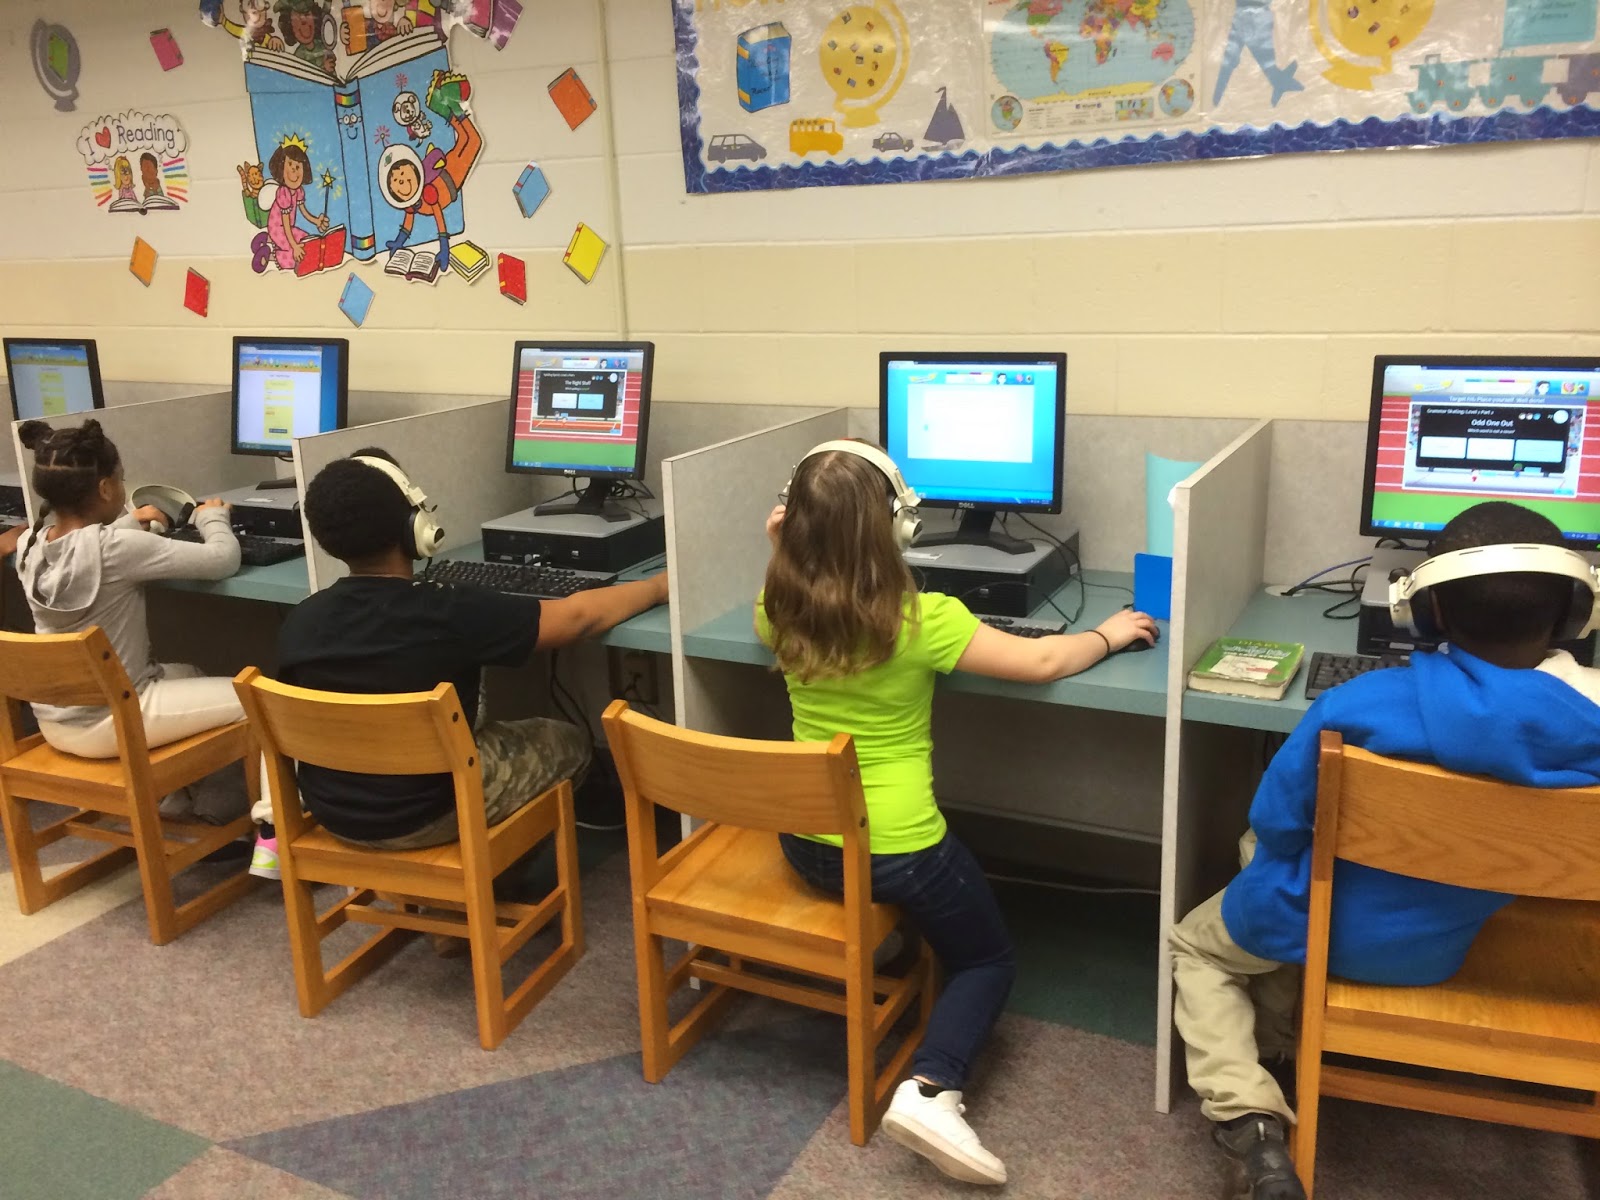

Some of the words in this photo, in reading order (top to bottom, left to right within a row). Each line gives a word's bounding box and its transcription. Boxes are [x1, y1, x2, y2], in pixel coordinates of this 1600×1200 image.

[85, 137, 95, 151] I
[116, 122, 175, 149] Reading
[1486, 419, 1500, 427] One
